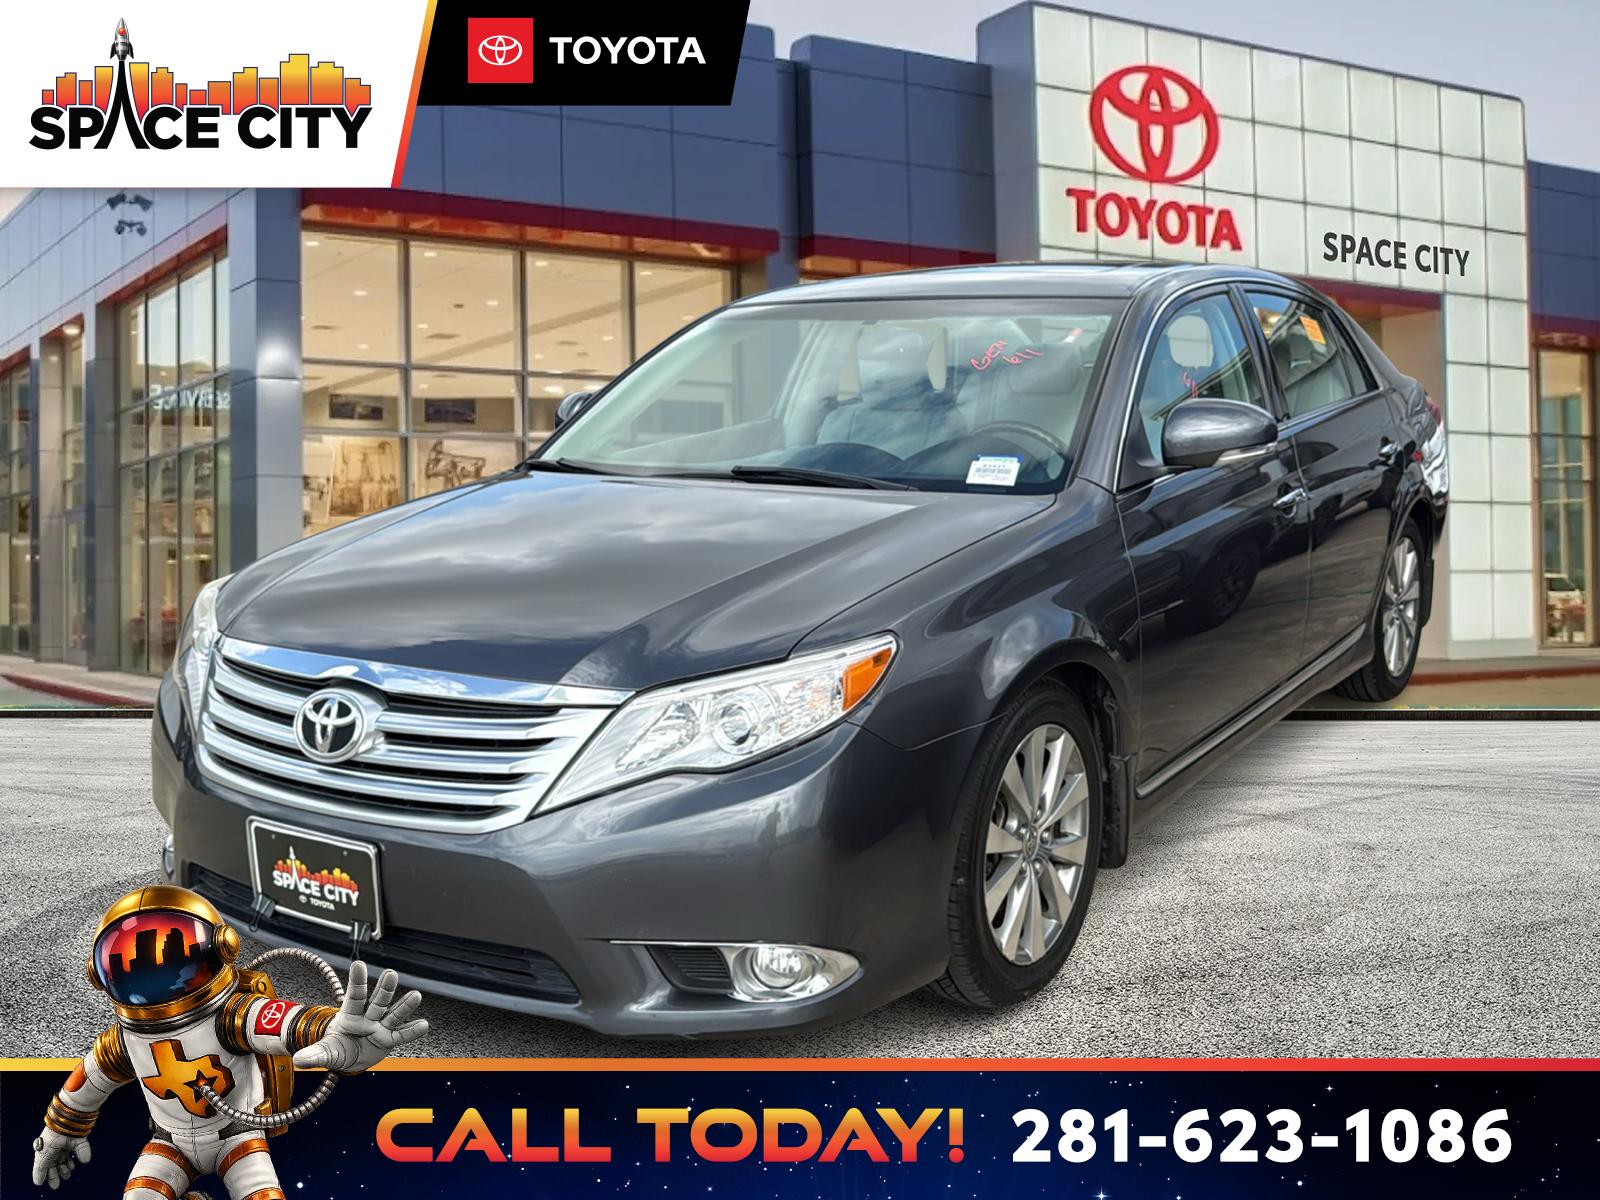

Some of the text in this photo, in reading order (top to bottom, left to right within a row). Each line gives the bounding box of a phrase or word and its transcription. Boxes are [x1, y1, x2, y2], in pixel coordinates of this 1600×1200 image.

[1066, 187, 1242, 251] TOYOTA
[1323, 231, 1470, 277] SPACE CITY
[272, 859, 359, 906] SPACE CITY
[309, 897, 335, 911] TOYOTA
